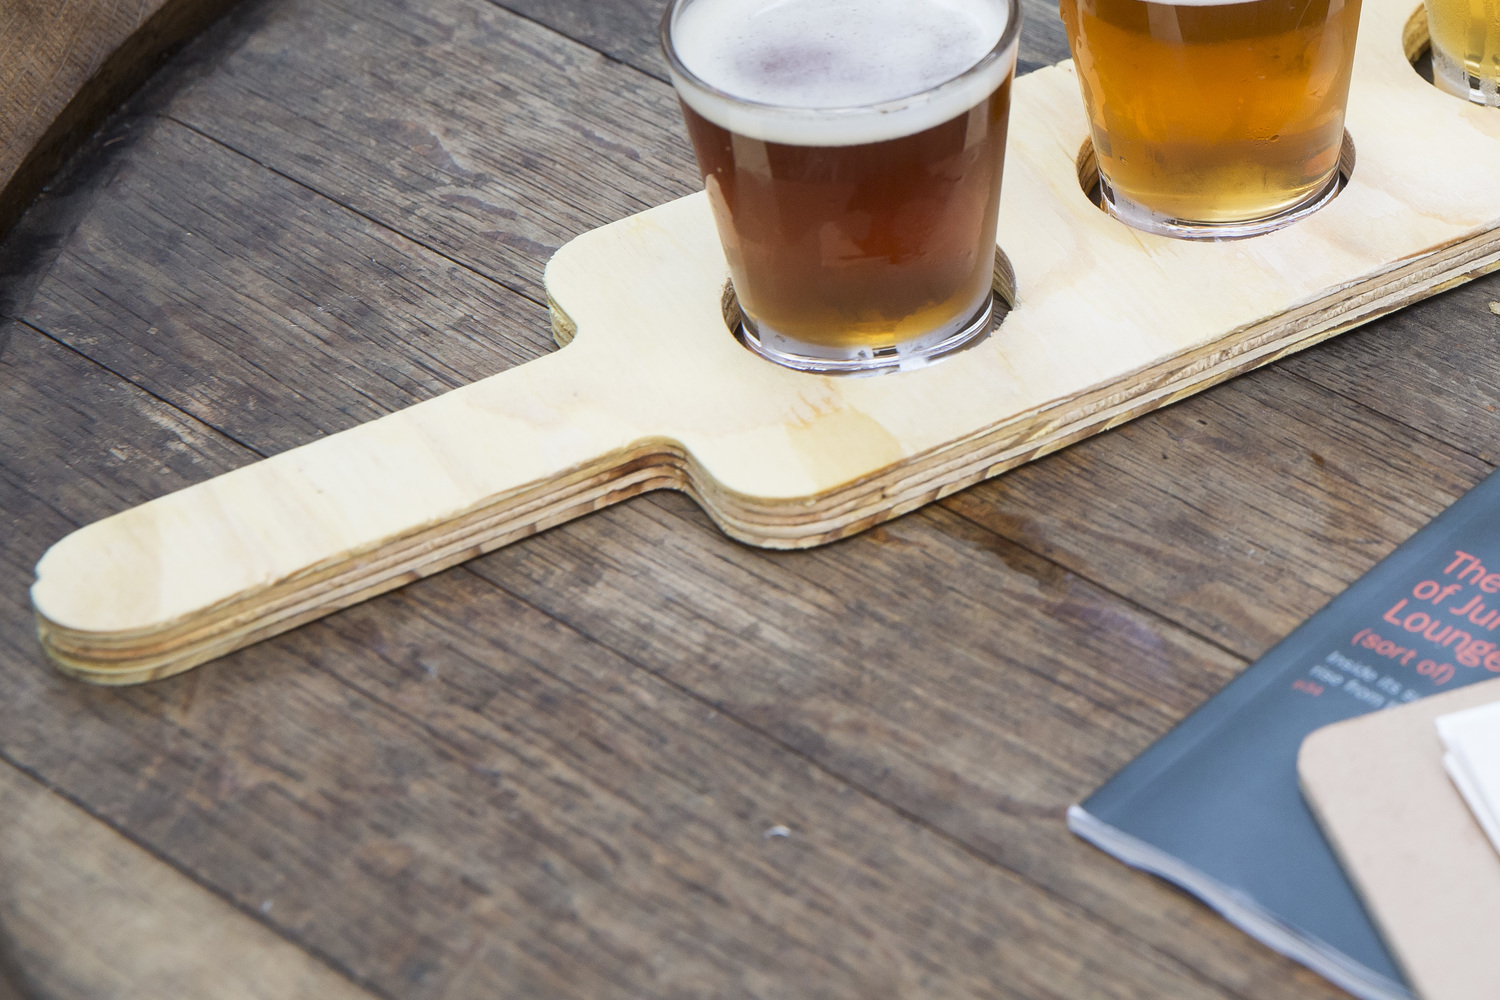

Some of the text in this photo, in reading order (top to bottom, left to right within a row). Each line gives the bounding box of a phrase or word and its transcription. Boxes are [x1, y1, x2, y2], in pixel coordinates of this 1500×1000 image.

[1413, 580, 1462, 607] of
[1352, 628, 1455, 686] (sort of)
